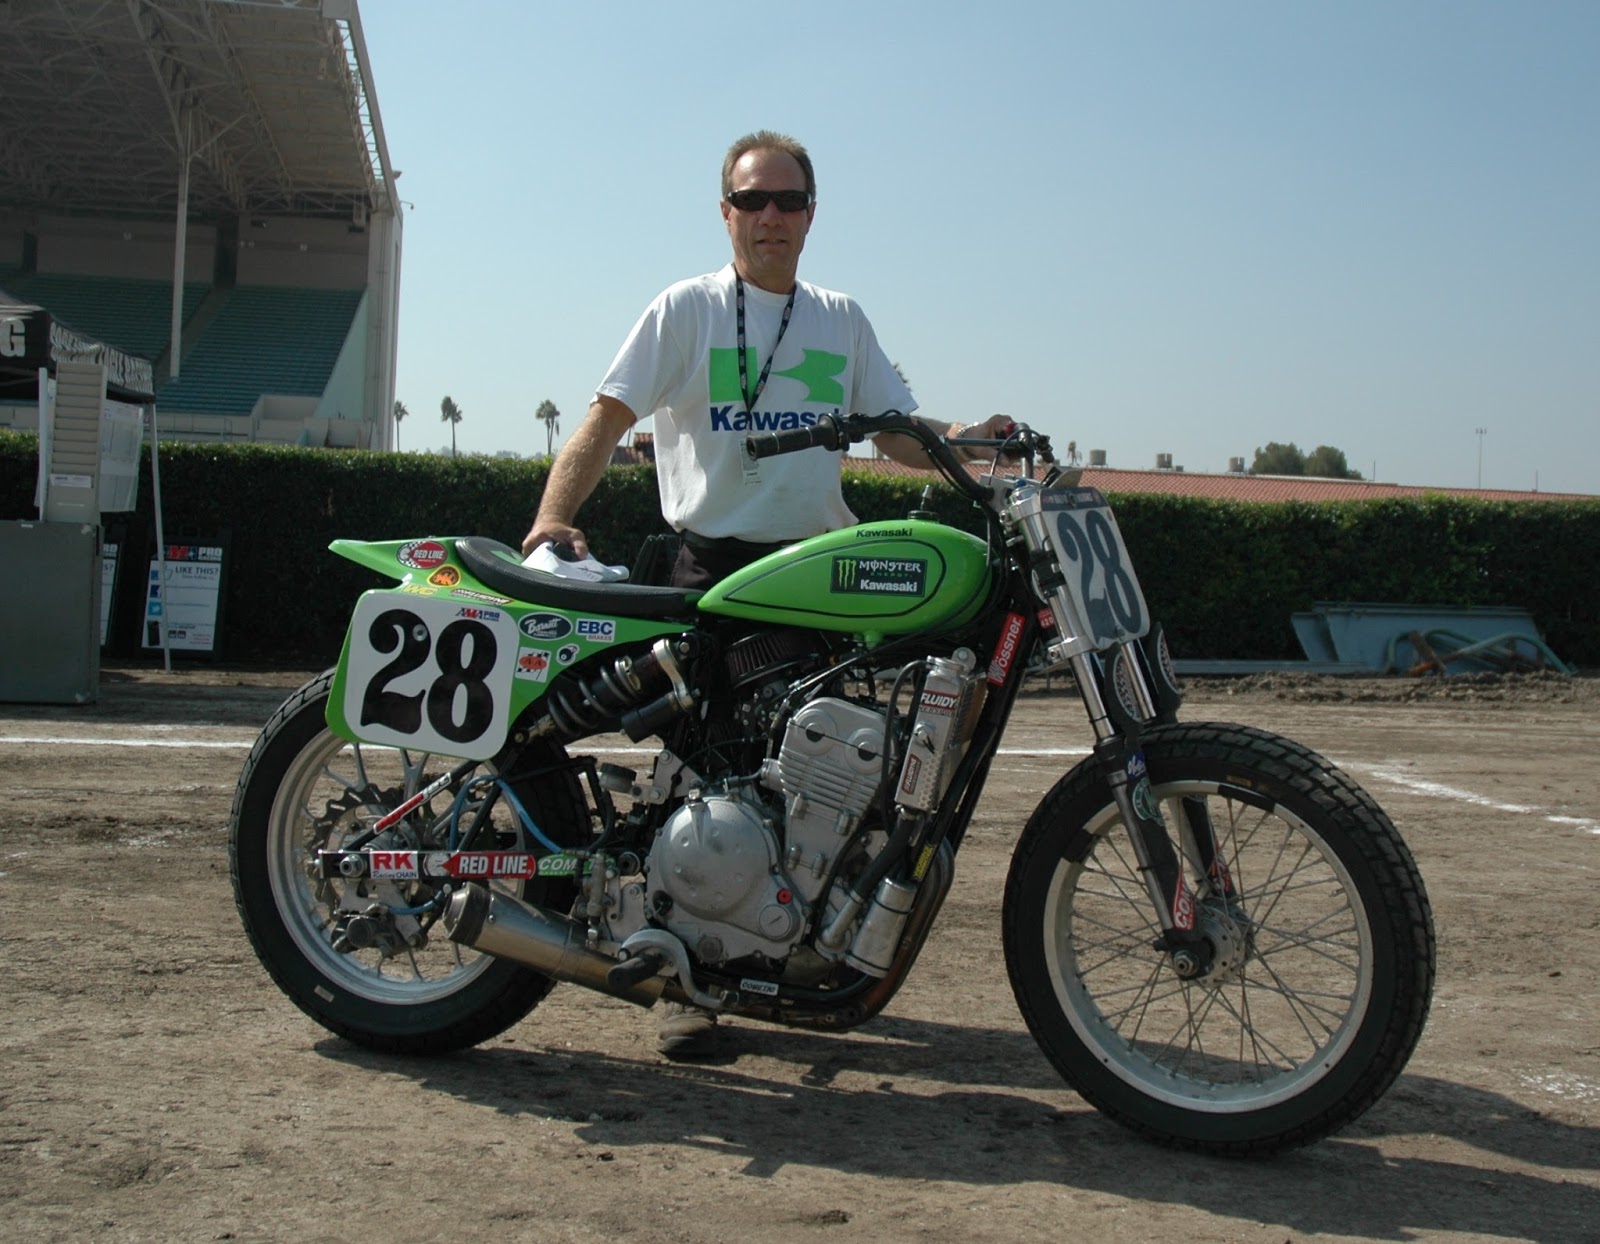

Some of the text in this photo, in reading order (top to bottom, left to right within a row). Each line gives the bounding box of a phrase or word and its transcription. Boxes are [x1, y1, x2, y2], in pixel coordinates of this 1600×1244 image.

[710, 405, 840, 431] Kawas
[856, 528, 913, 538] Kawasaki
[198, 547, 222, 557] PRO
[413, 550, 444, 559] RED LINE
[175, 566, 219, 575] LIKE THIS?
[1057, 510, 1141, 645] 28
[860, 579, 917, 592] Kawasaki
[456, 608, 483, 619] AMA
[578, 621, 613, 635] EBC
[360, 608, 497, 743] 28
[920, 692, 959, 709] FLUIDY
[373, 853, 414, 870] RK
[459, 856, 529, 875] RED LINE
